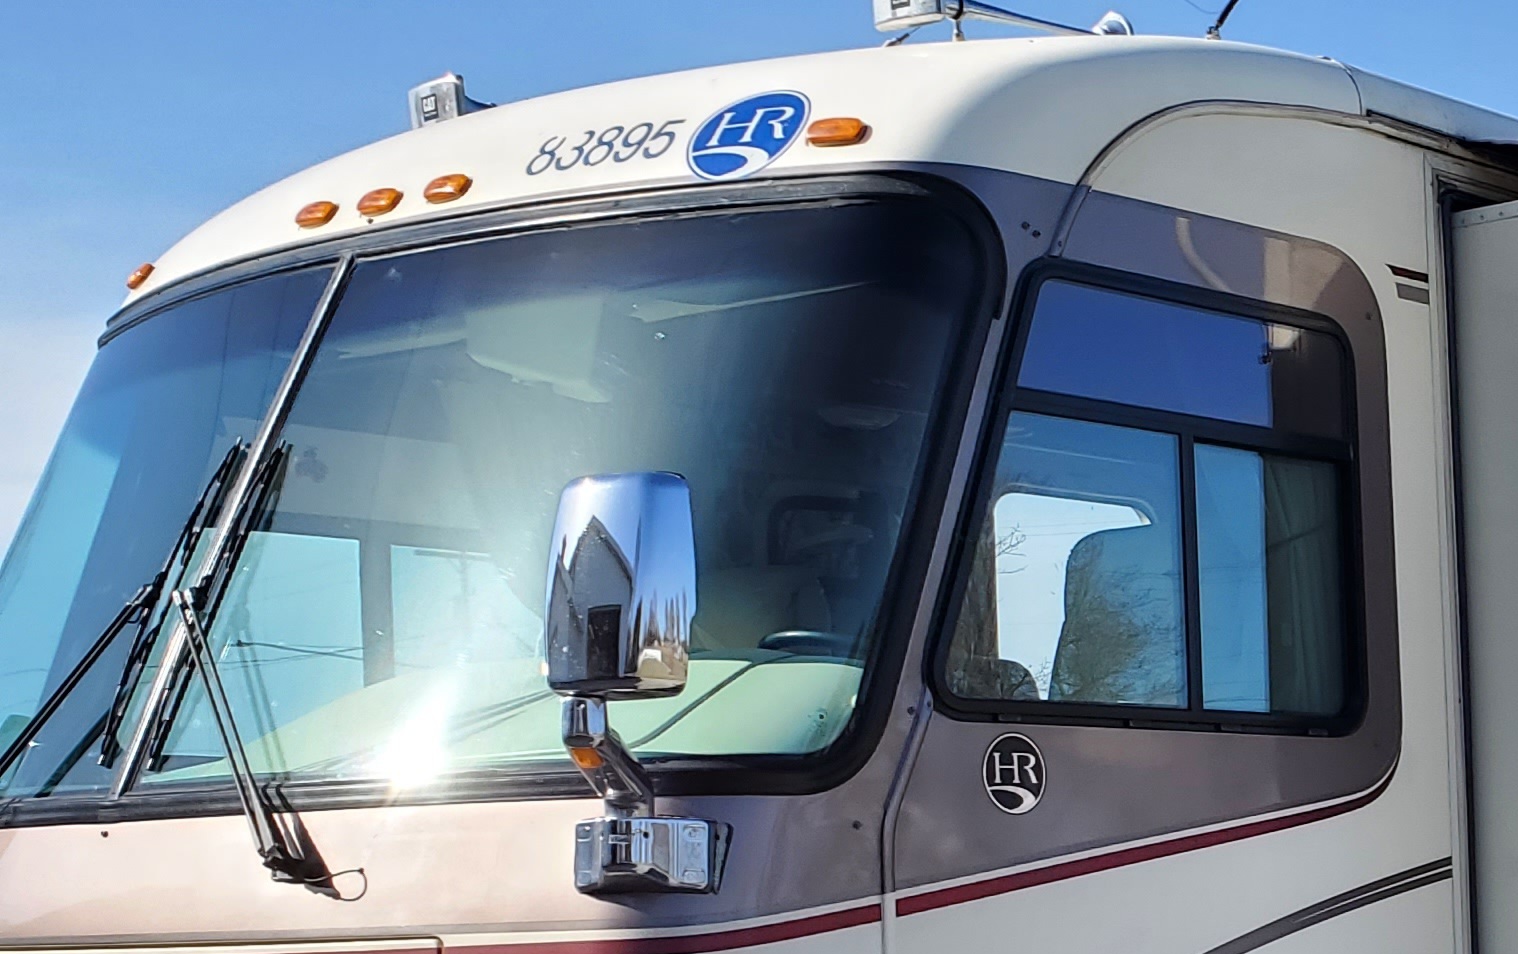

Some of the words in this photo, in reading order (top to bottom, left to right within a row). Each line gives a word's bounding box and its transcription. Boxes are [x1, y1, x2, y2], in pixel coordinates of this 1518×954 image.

[525, 118, 687, 176] 83895
[705, 106, 796, 148] HR
[993, 752, 1039, 784] HR
